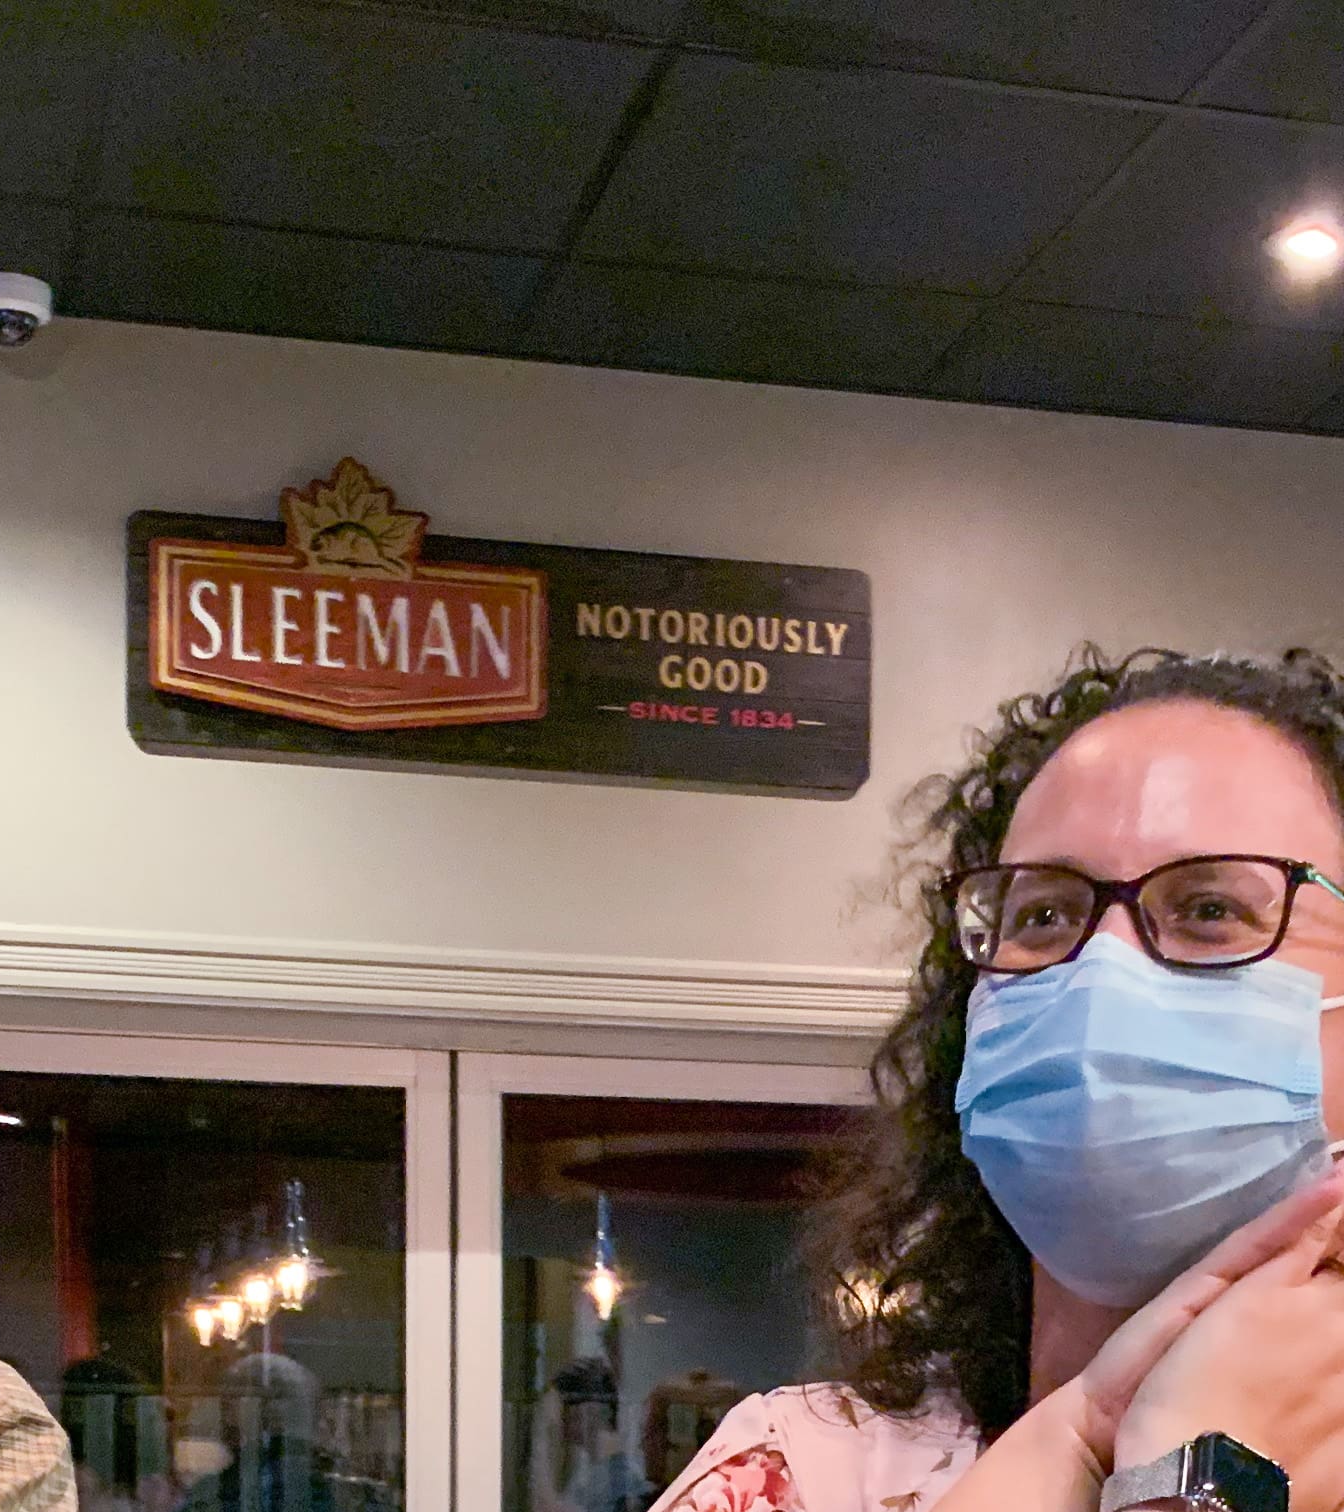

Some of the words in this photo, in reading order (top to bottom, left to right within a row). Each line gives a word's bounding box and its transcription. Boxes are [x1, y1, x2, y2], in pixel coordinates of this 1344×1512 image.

[187, 578, 512, 681] SLEEMAN
[576, 603, 849, 656] NOTORIOUSLY
[659, 655, 768, 694] GOOD
[627, 701, 720, 725] SINCE
[730, 710, 794, 729] 1834
